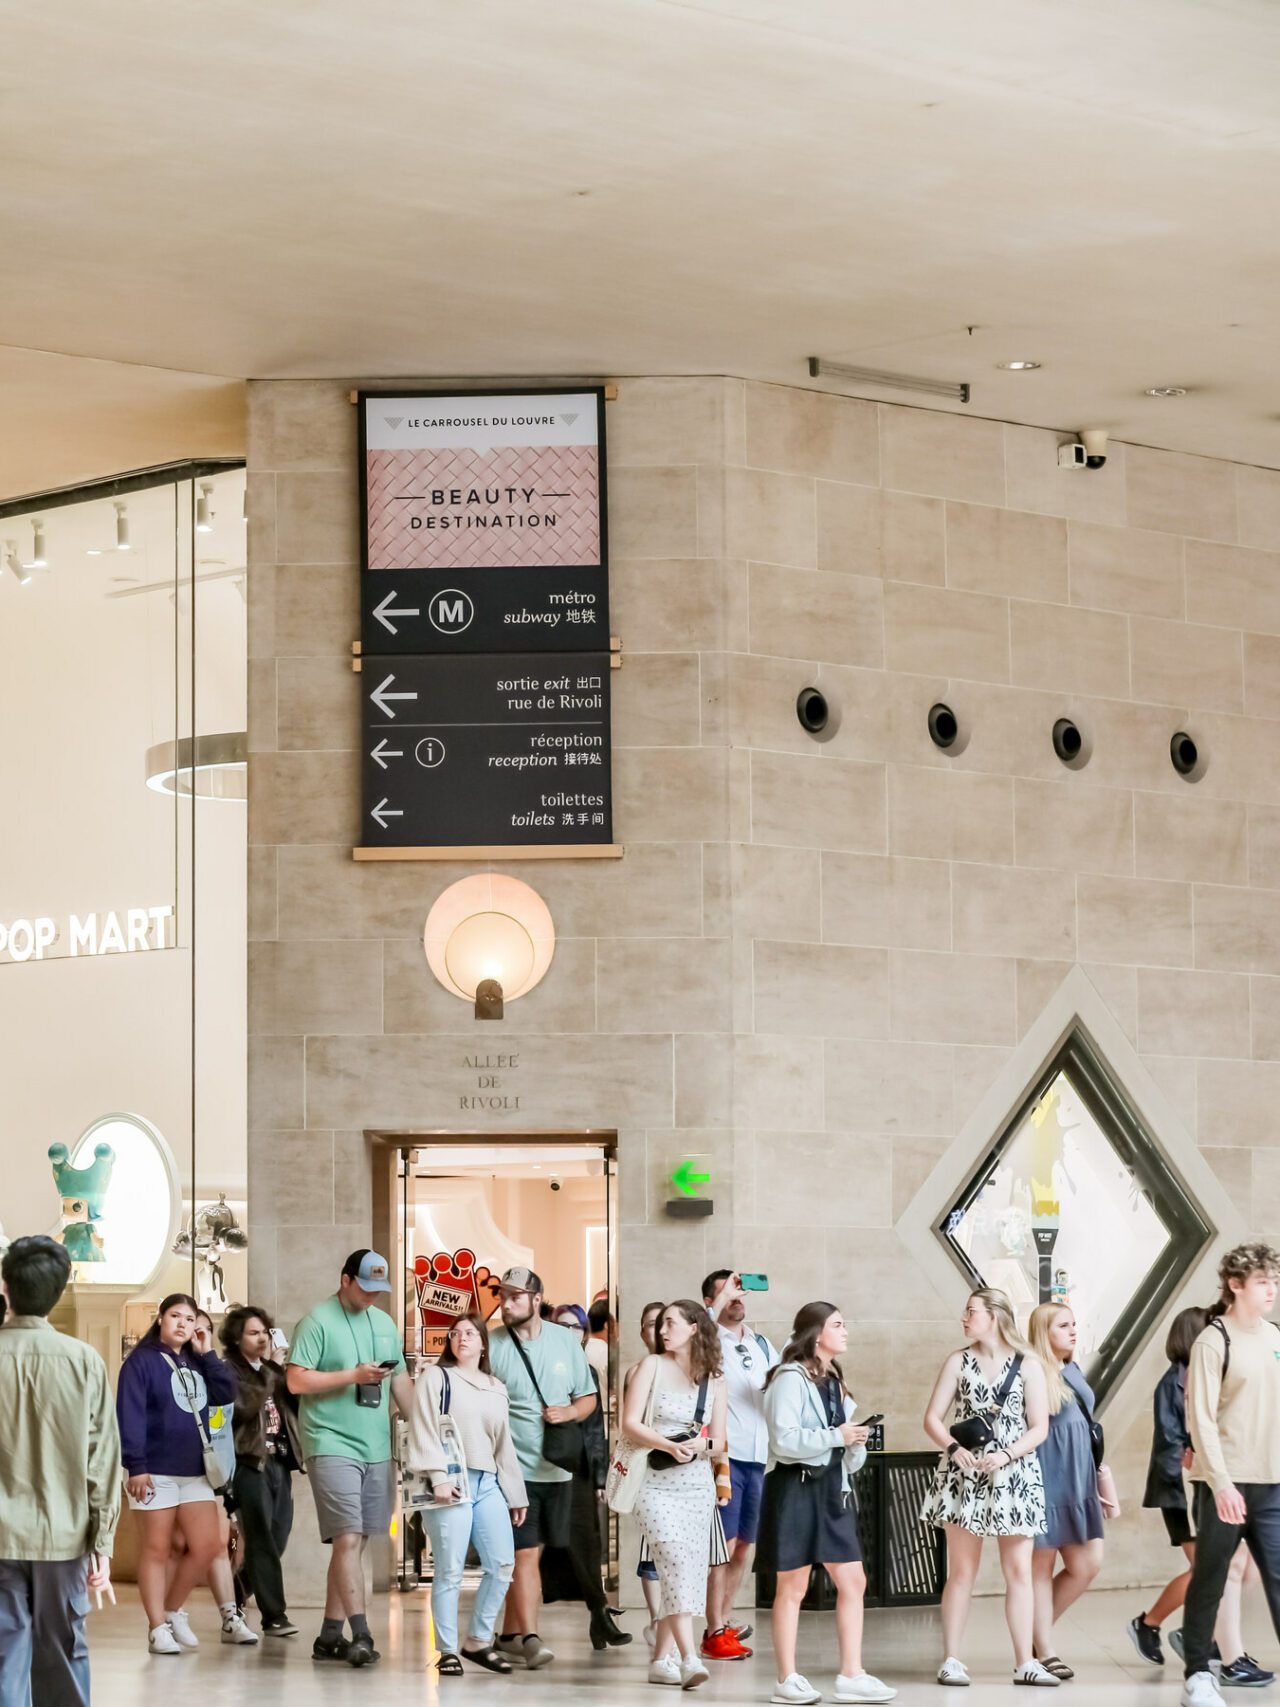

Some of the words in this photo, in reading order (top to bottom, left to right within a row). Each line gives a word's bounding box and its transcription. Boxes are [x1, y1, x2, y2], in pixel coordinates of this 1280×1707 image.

[408, 419, 420, 428] LE
[423, 417, 489, 428] CARROUSEL
[492, 417, 508, 427] DU
[511, 416, 556, 426] LOUVRE
[431, 487, 536, 505] BEAUTY
[410, 514, 557, 530] DESTINATION
[549, 590, 596, 604] métro
[503, 608, 561, 627] subway
[566, 608, 596, 624] 地铁
[496, 677, 540, 691] sortie
[543, 677, 571, 690] exit
[576, 676, 602, 690] 出口
[507, 698, 533, 710] rue
[537, 696, 555, 709] de
[559, 694, 602, 709] Rivoli
[531, 733, 603, 750] réception
[488, 753, 558, 771] reception
[564, 752, 602, 766] 接待处
[541, 792, 604, 807] toilettes
[511, 811, 556, 827] toilets
[561, 812, 605, 826] 洗手间
[69, 904, 174, 958] MART
[478, 1076, 502, 1089] DE
[459, 1095, 520, 1110] RIVOLI
[432, 1289, 461, 1305] NEW
[425, 1298, 464, 1313] ARRIVALS!!
